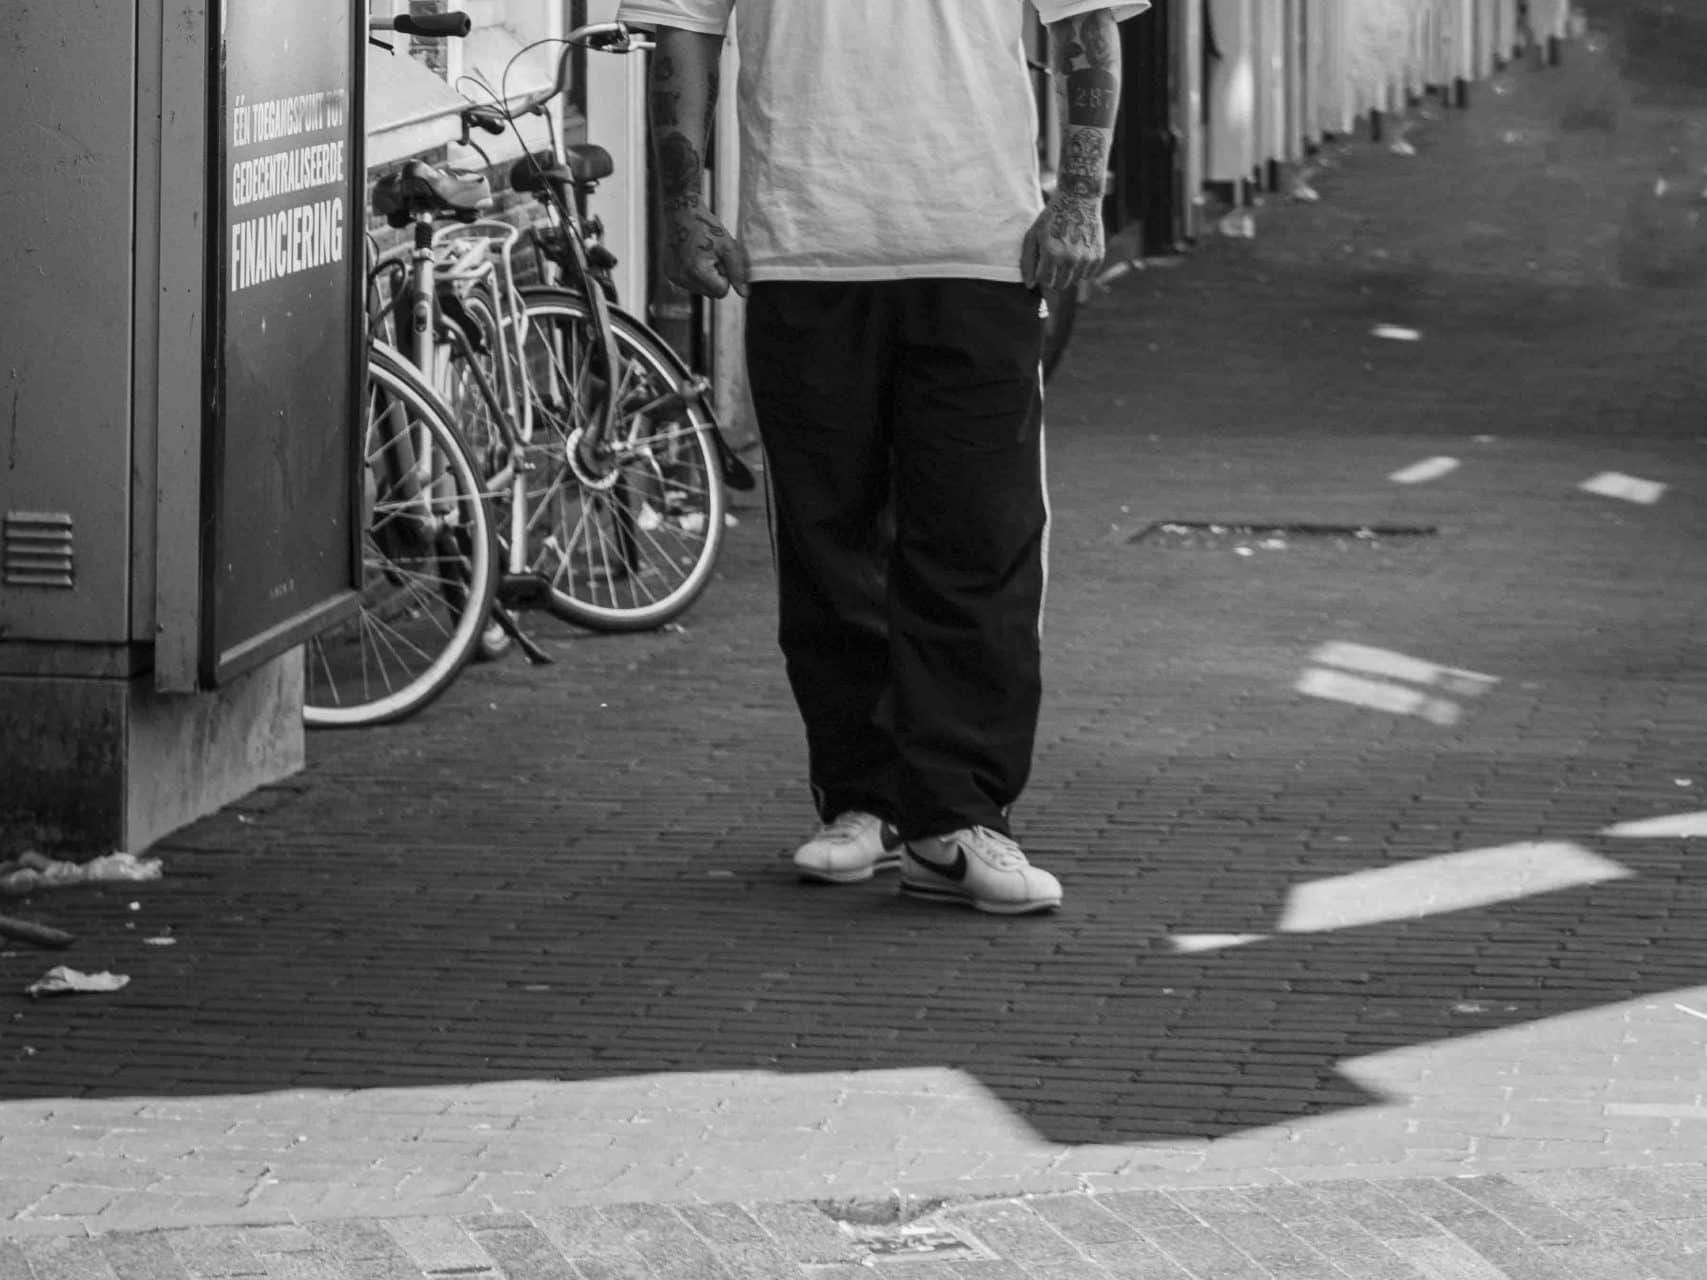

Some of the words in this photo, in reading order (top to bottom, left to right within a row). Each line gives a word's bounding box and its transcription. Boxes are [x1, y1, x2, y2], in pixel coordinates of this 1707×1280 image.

[233, 94, 250, 147] ÉÉN
[252, 91, 323, 143] TOEGANGSPUNT
[233, 140, 344, 206] GEDECENTRALISEERDE
[231, 197, 344, 292] FINANCIERING
